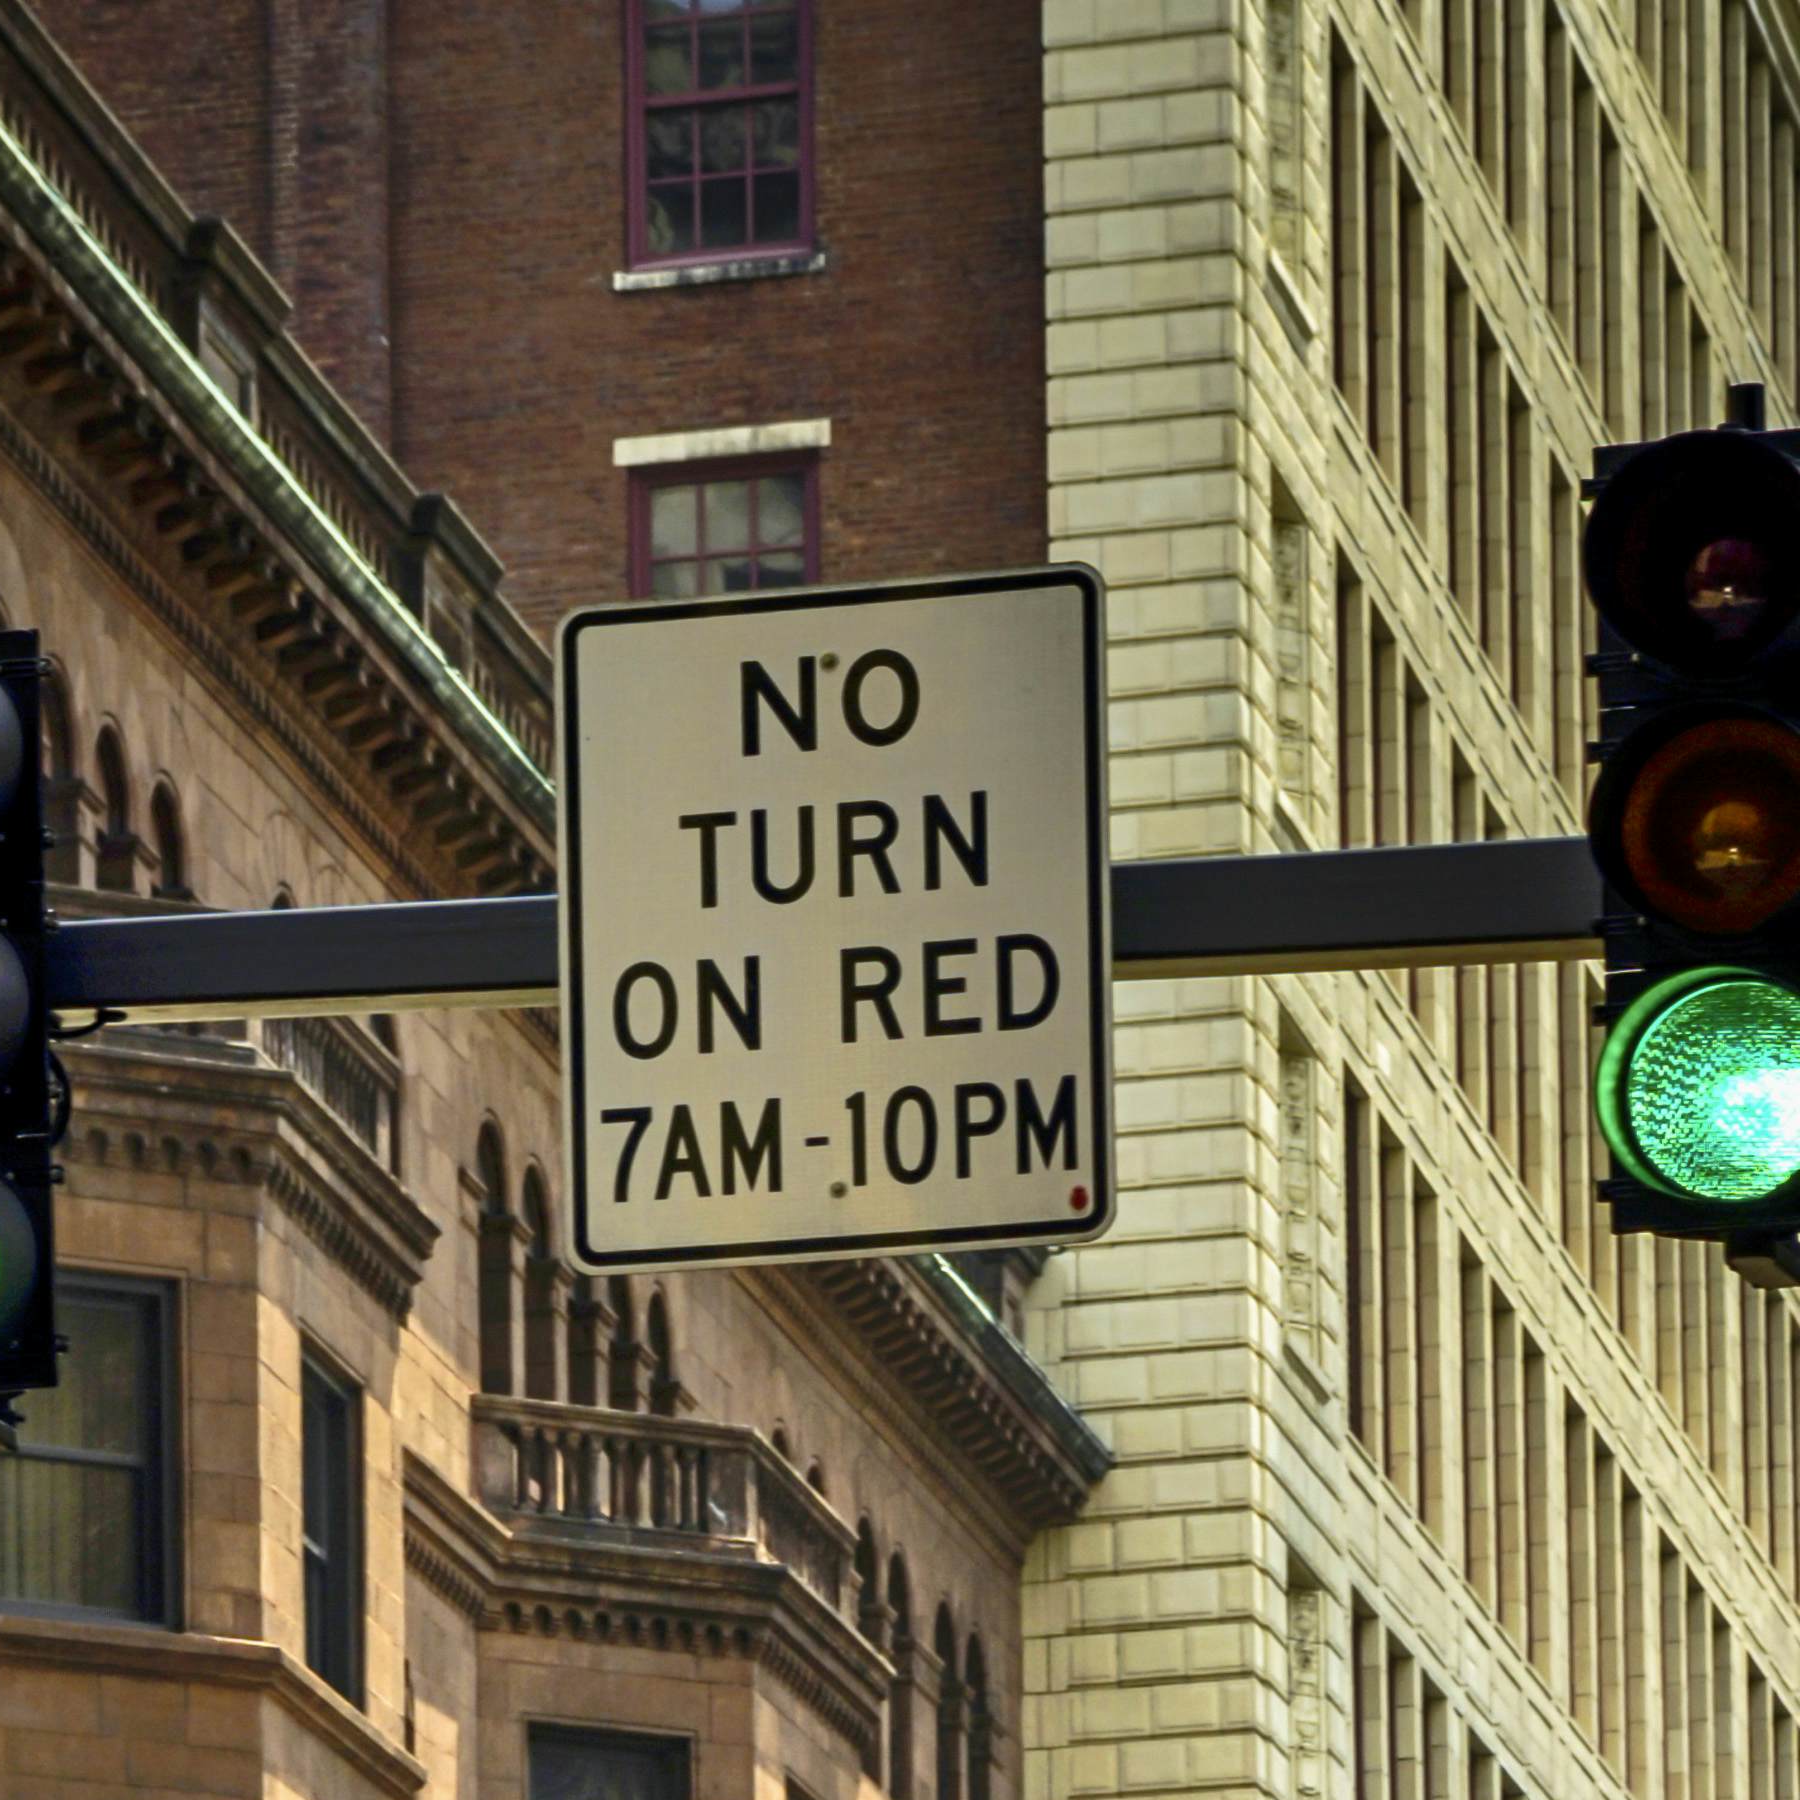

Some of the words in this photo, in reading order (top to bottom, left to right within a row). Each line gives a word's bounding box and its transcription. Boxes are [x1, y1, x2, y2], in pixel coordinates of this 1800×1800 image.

[740, 648, 921, 757] NO
[678, 790, 989, 908] TURN
[611, 954, 762, 1060] ON
[840, 933, 1061, 1043] RED
[600, 1074, 1080, 1203] 7AM-10PM
